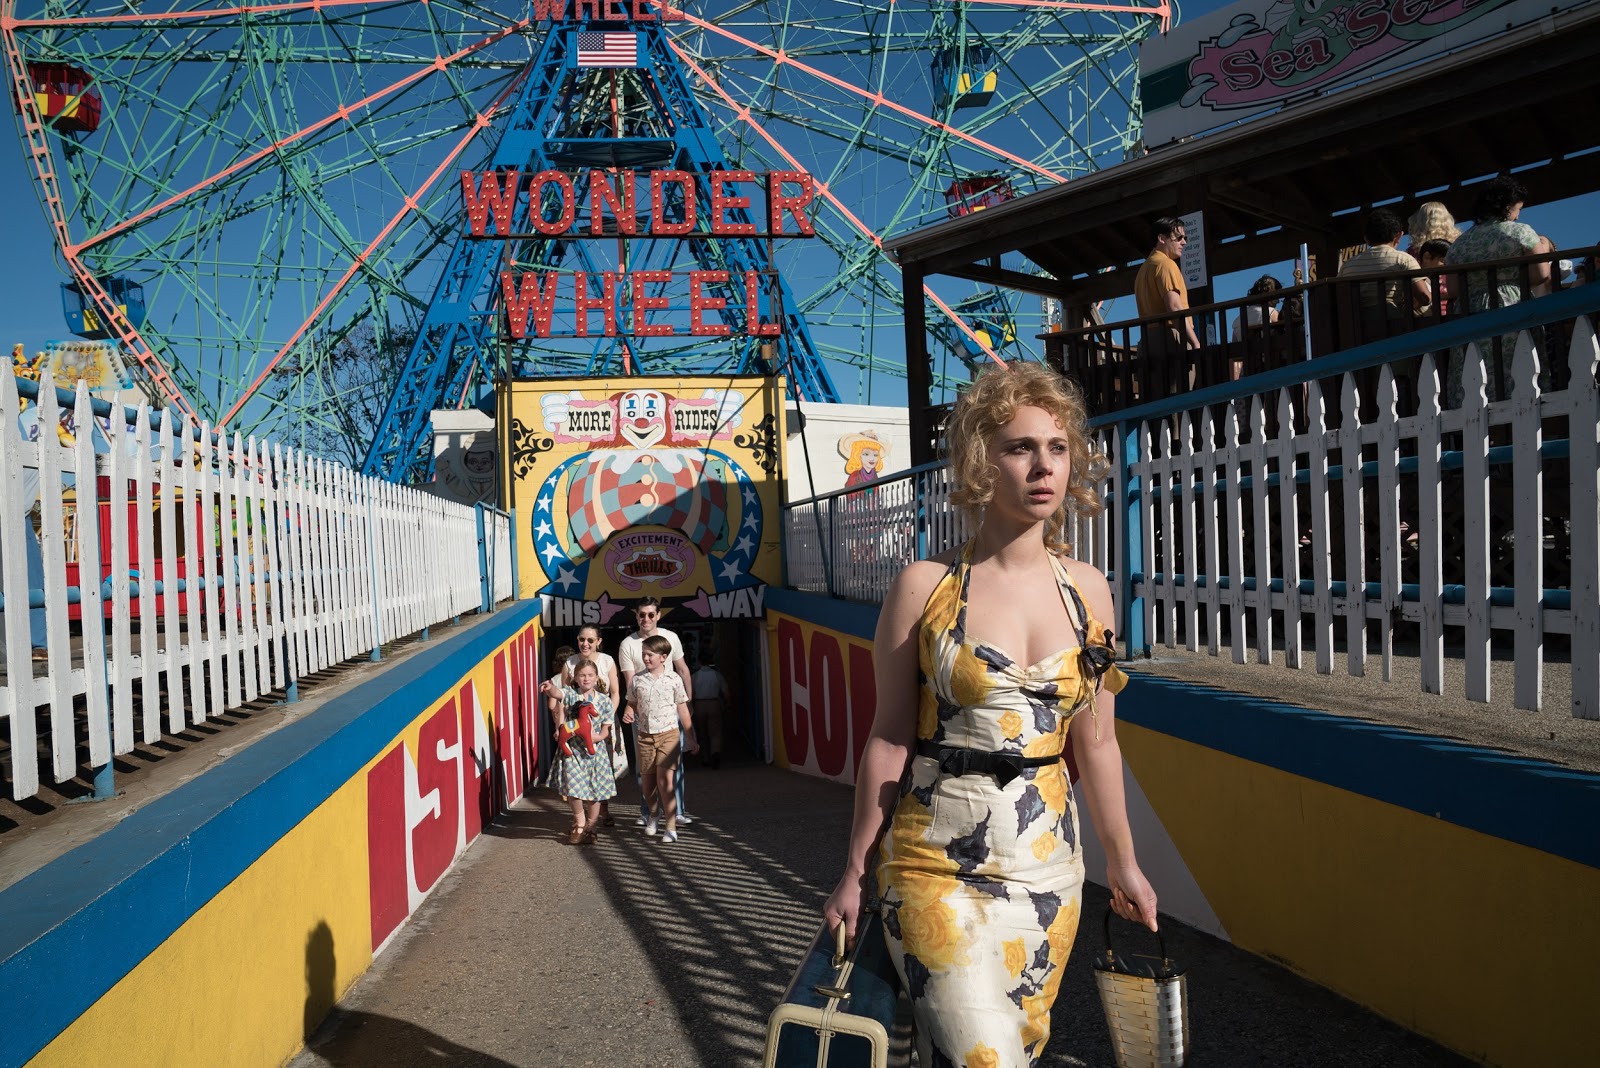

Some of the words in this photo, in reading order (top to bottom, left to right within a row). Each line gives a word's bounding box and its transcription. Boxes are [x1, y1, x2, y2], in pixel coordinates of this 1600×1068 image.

[1220, 36, 1333, 91] Sea
[461, 170, 815, 236] WONDER
[501, 271, 781, 338] WHEEL
[568, 411, 611, 432] MORE
[674, 410, 718, 431] RIDES
[618, 534, 683, 549] EXCITEMENT
[628, 560, 672, 576] THRILLS
[540, 593, 600, 627] THIS
[709, 584, 767, 618] WAY
[367, 624, 539, 955] ISLAND
